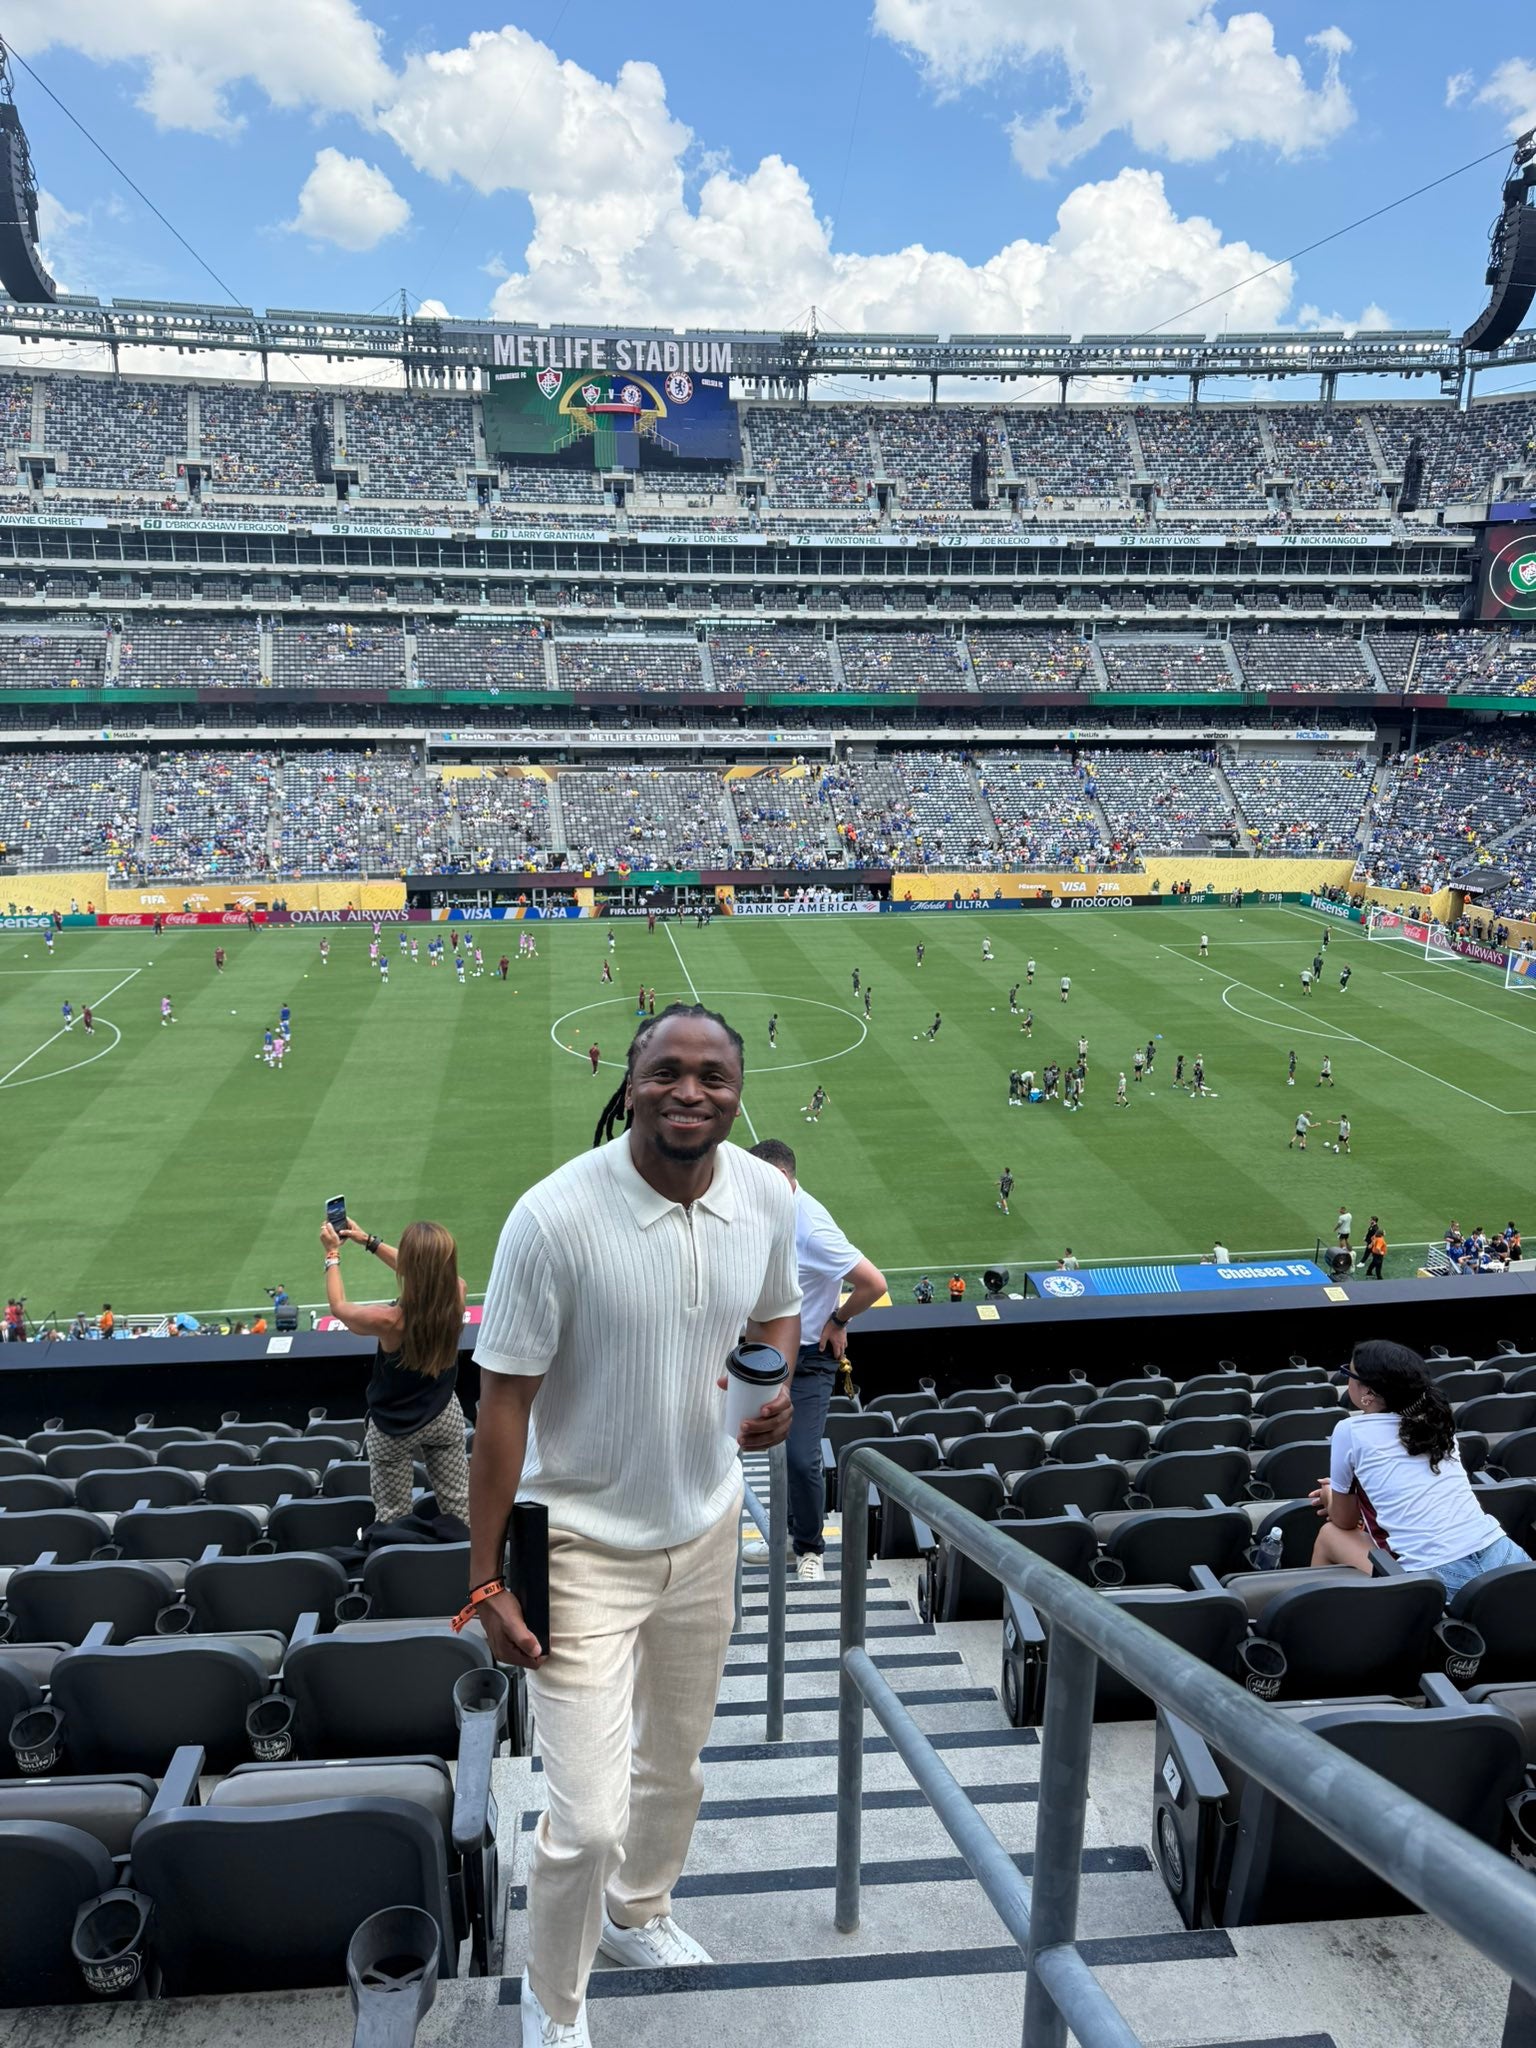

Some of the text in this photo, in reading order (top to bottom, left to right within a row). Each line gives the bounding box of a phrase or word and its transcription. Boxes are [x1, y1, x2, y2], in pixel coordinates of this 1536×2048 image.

[493, 334, 732, 373] METLIFE STADIUM
[38, 516, 84, 526] CHREBET
[144, 520, 162, 528] 60
[238, 522, 286, 532] FERGUSON
[332, 524, 435, 536] 99 MARK GASTINEAU
[491, 530, 508, 538] 60
[544, 532, 595, 540] GRANTHAM
[694, 534, 716, 542] LEON
[718, 535, 738, 543] HESS
[796, 536, 810, 544] 75
[824, 536, 866, 544] WINSTON
[948, 536, 962, 545] 73
[1120, 536, 1136, 545] 93
[1282, 536, 1297, 545] 74
[1060, 882, 1087, 892] VISA
[140, 895, 166, 904] FIFA
[1071, 896, 1133, 908] motorola
[1191, 895, 1205, 903] PIF
[738, 902, 858, 914] BANK OF AMERICA
[955, 900, 990, 909] ULTRA
[1310, 896, 1350, 918] Hisense
[290, 910, 409, 922] QATAR AIRWAYS
[462, 908, 492, 919] VISA
[1465, 943, 1503, 964] AIRWAYS
[1217, 1264, 1311, 1280] Chelsea FC
